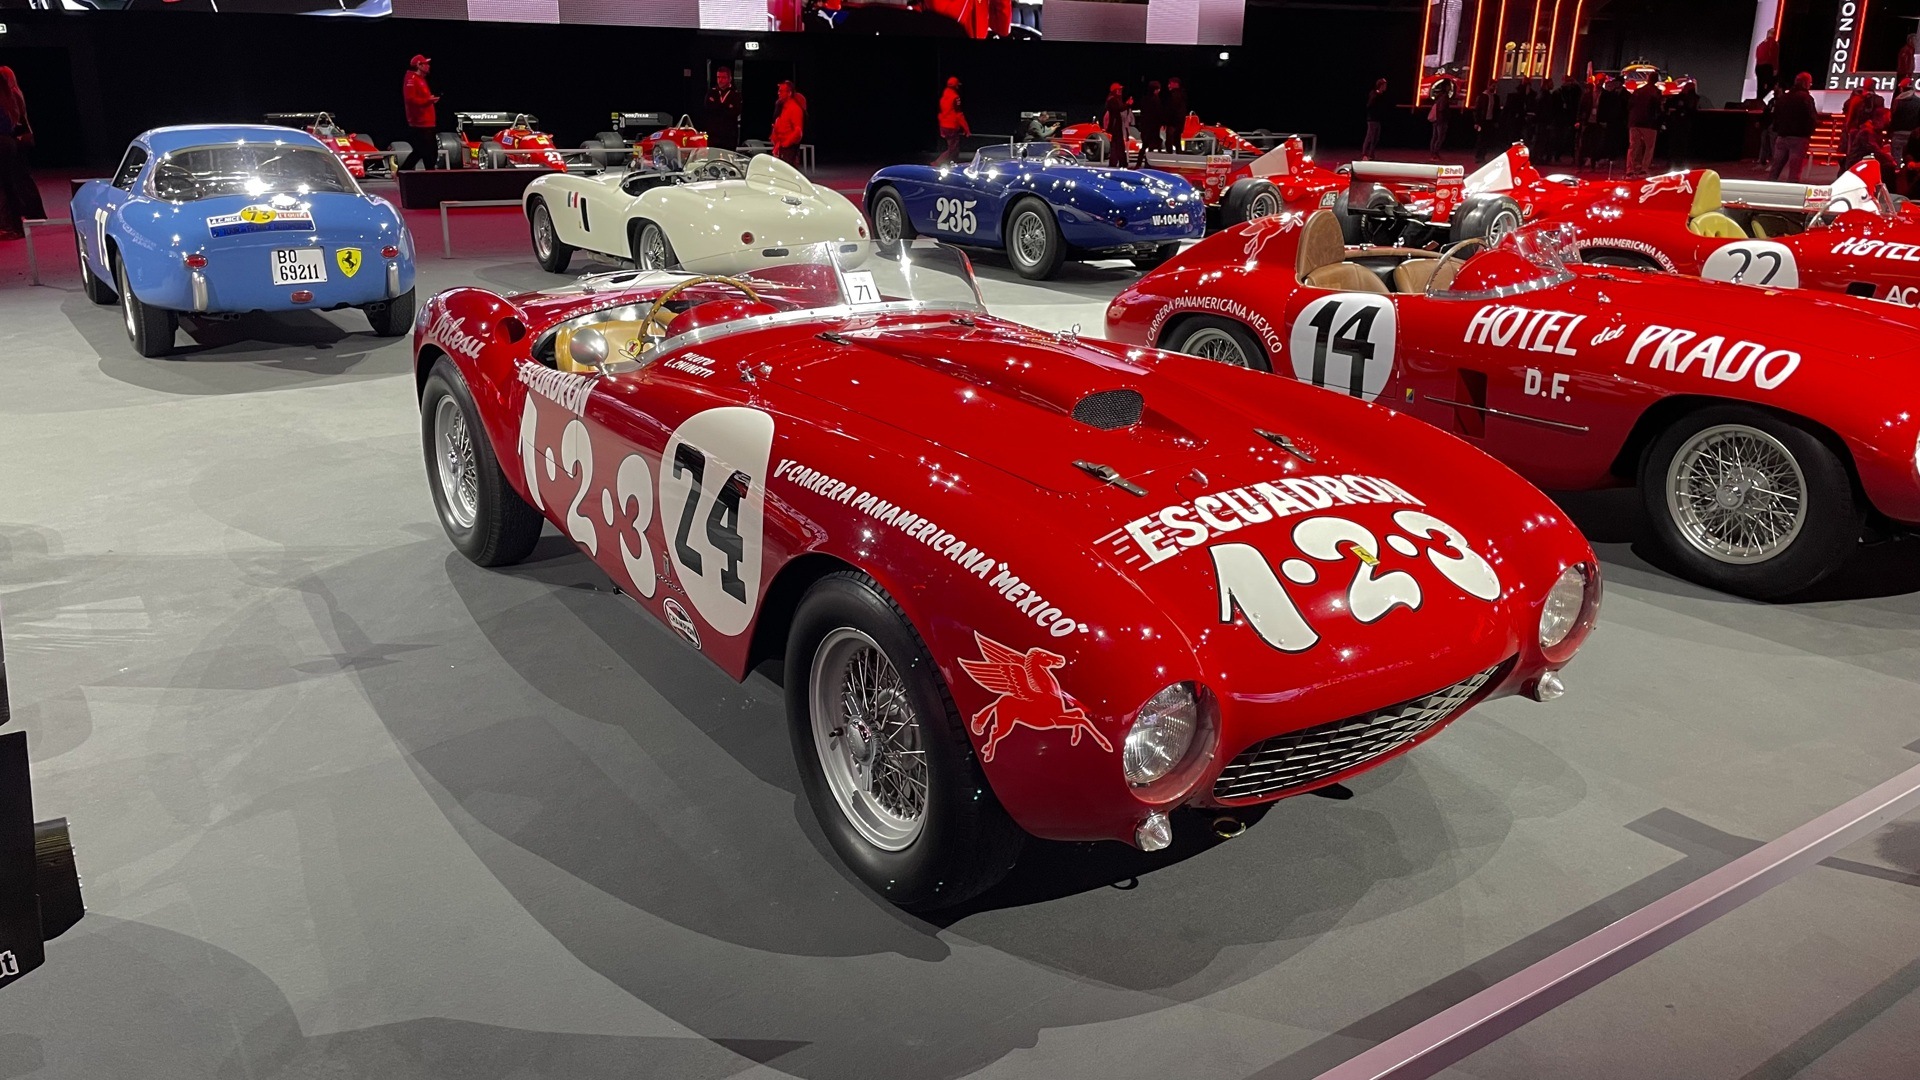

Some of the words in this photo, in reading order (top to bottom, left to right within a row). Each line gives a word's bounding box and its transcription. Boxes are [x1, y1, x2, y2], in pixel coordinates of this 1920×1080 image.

[1444, 167, 1463, 175] Shell
[936, 197, 977, 235] 235
[280, 264, 319, 281] 69211
[1592, 236, 1657, 257] PANAMERICANA
[1146, 301, 1175, 342] CARRERA
[1174, 296, 1247, 319] PANAMERICANA
[1248, 309, 1284, 354] MEXICO
[1309, 300, 1381, 399] 14
[1463, 304, 1587, 357] HOTEL
[1590, 323, 1627, 347] del
[1625, 324, 1801, 390] PRADO
[518, 358, 600, 418] ESCUADRON
[1524, 368, 1572, 403] D.F.
[850, 491, 996, 580] PANAMERICANA
[1122, 474, 1427, 565] ESCUADRON
